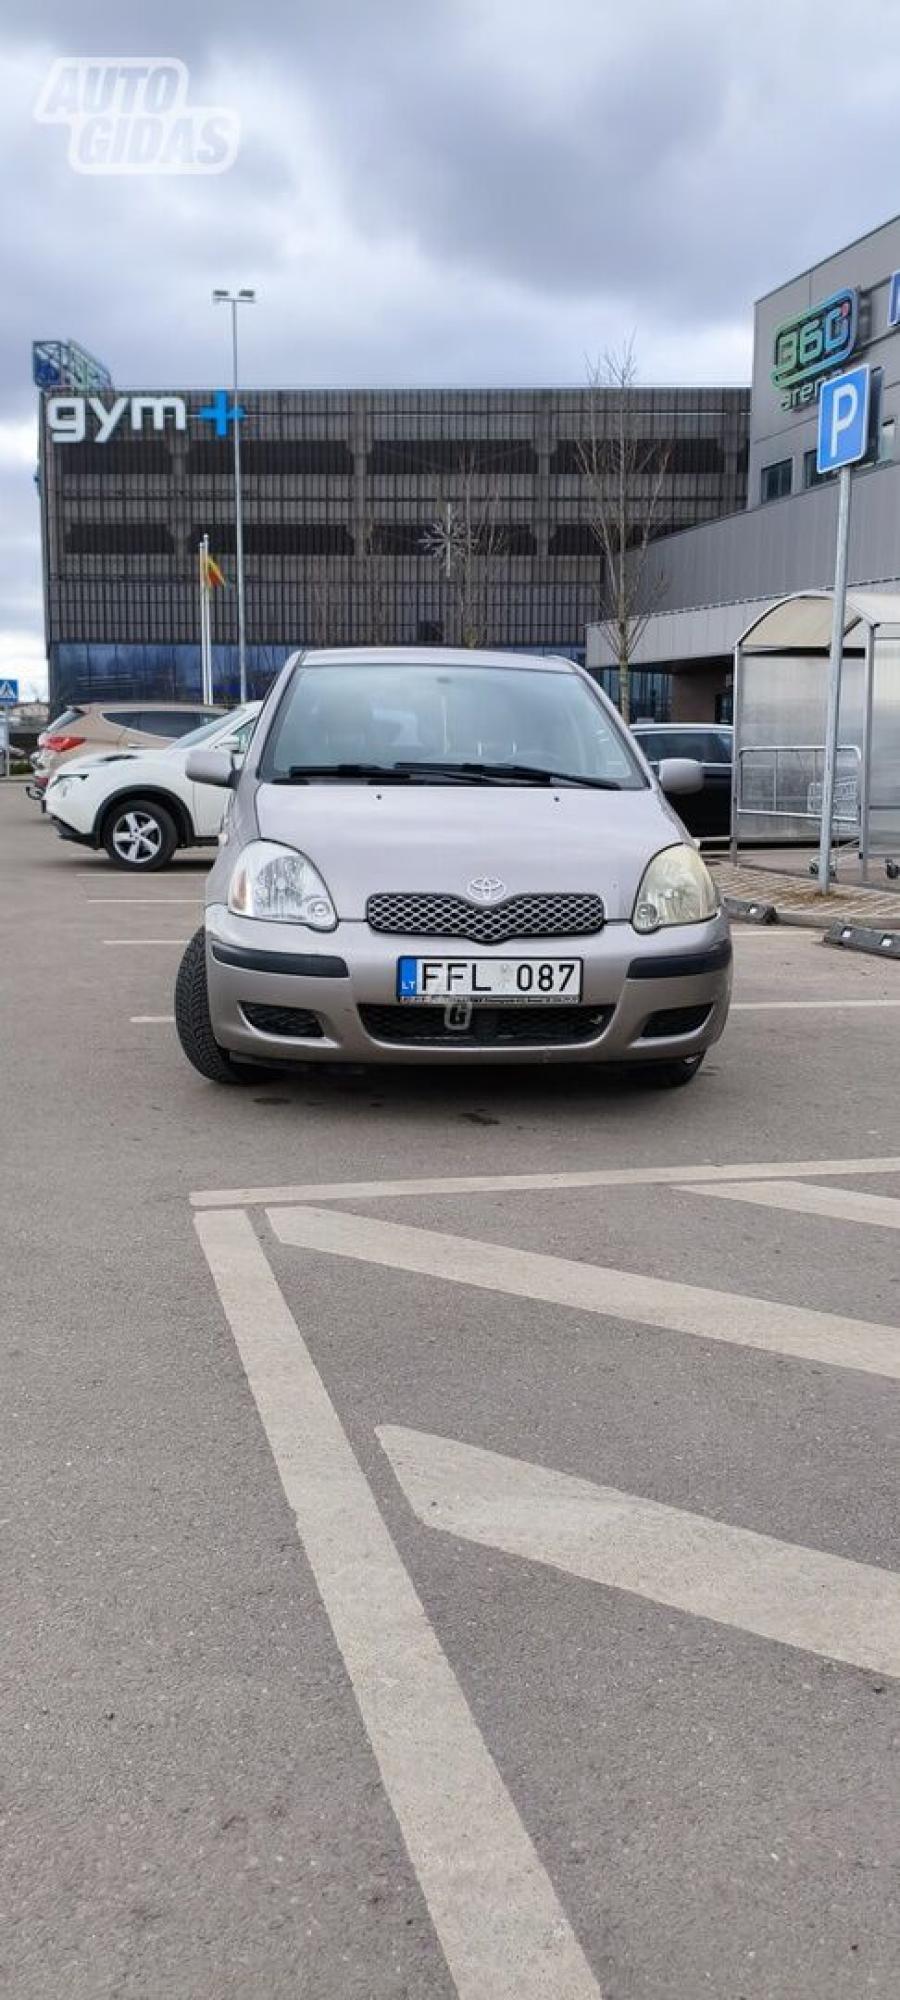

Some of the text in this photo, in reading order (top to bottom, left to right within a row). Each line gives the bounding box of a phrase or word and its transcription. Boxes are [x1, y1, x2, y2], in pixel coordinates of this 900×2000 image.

[780, 368, 844, 411] aren
[830, 383, 858, 459] P
[401, 980, 416, 990] LT
[421, 962, 575, 992] FFL 087
